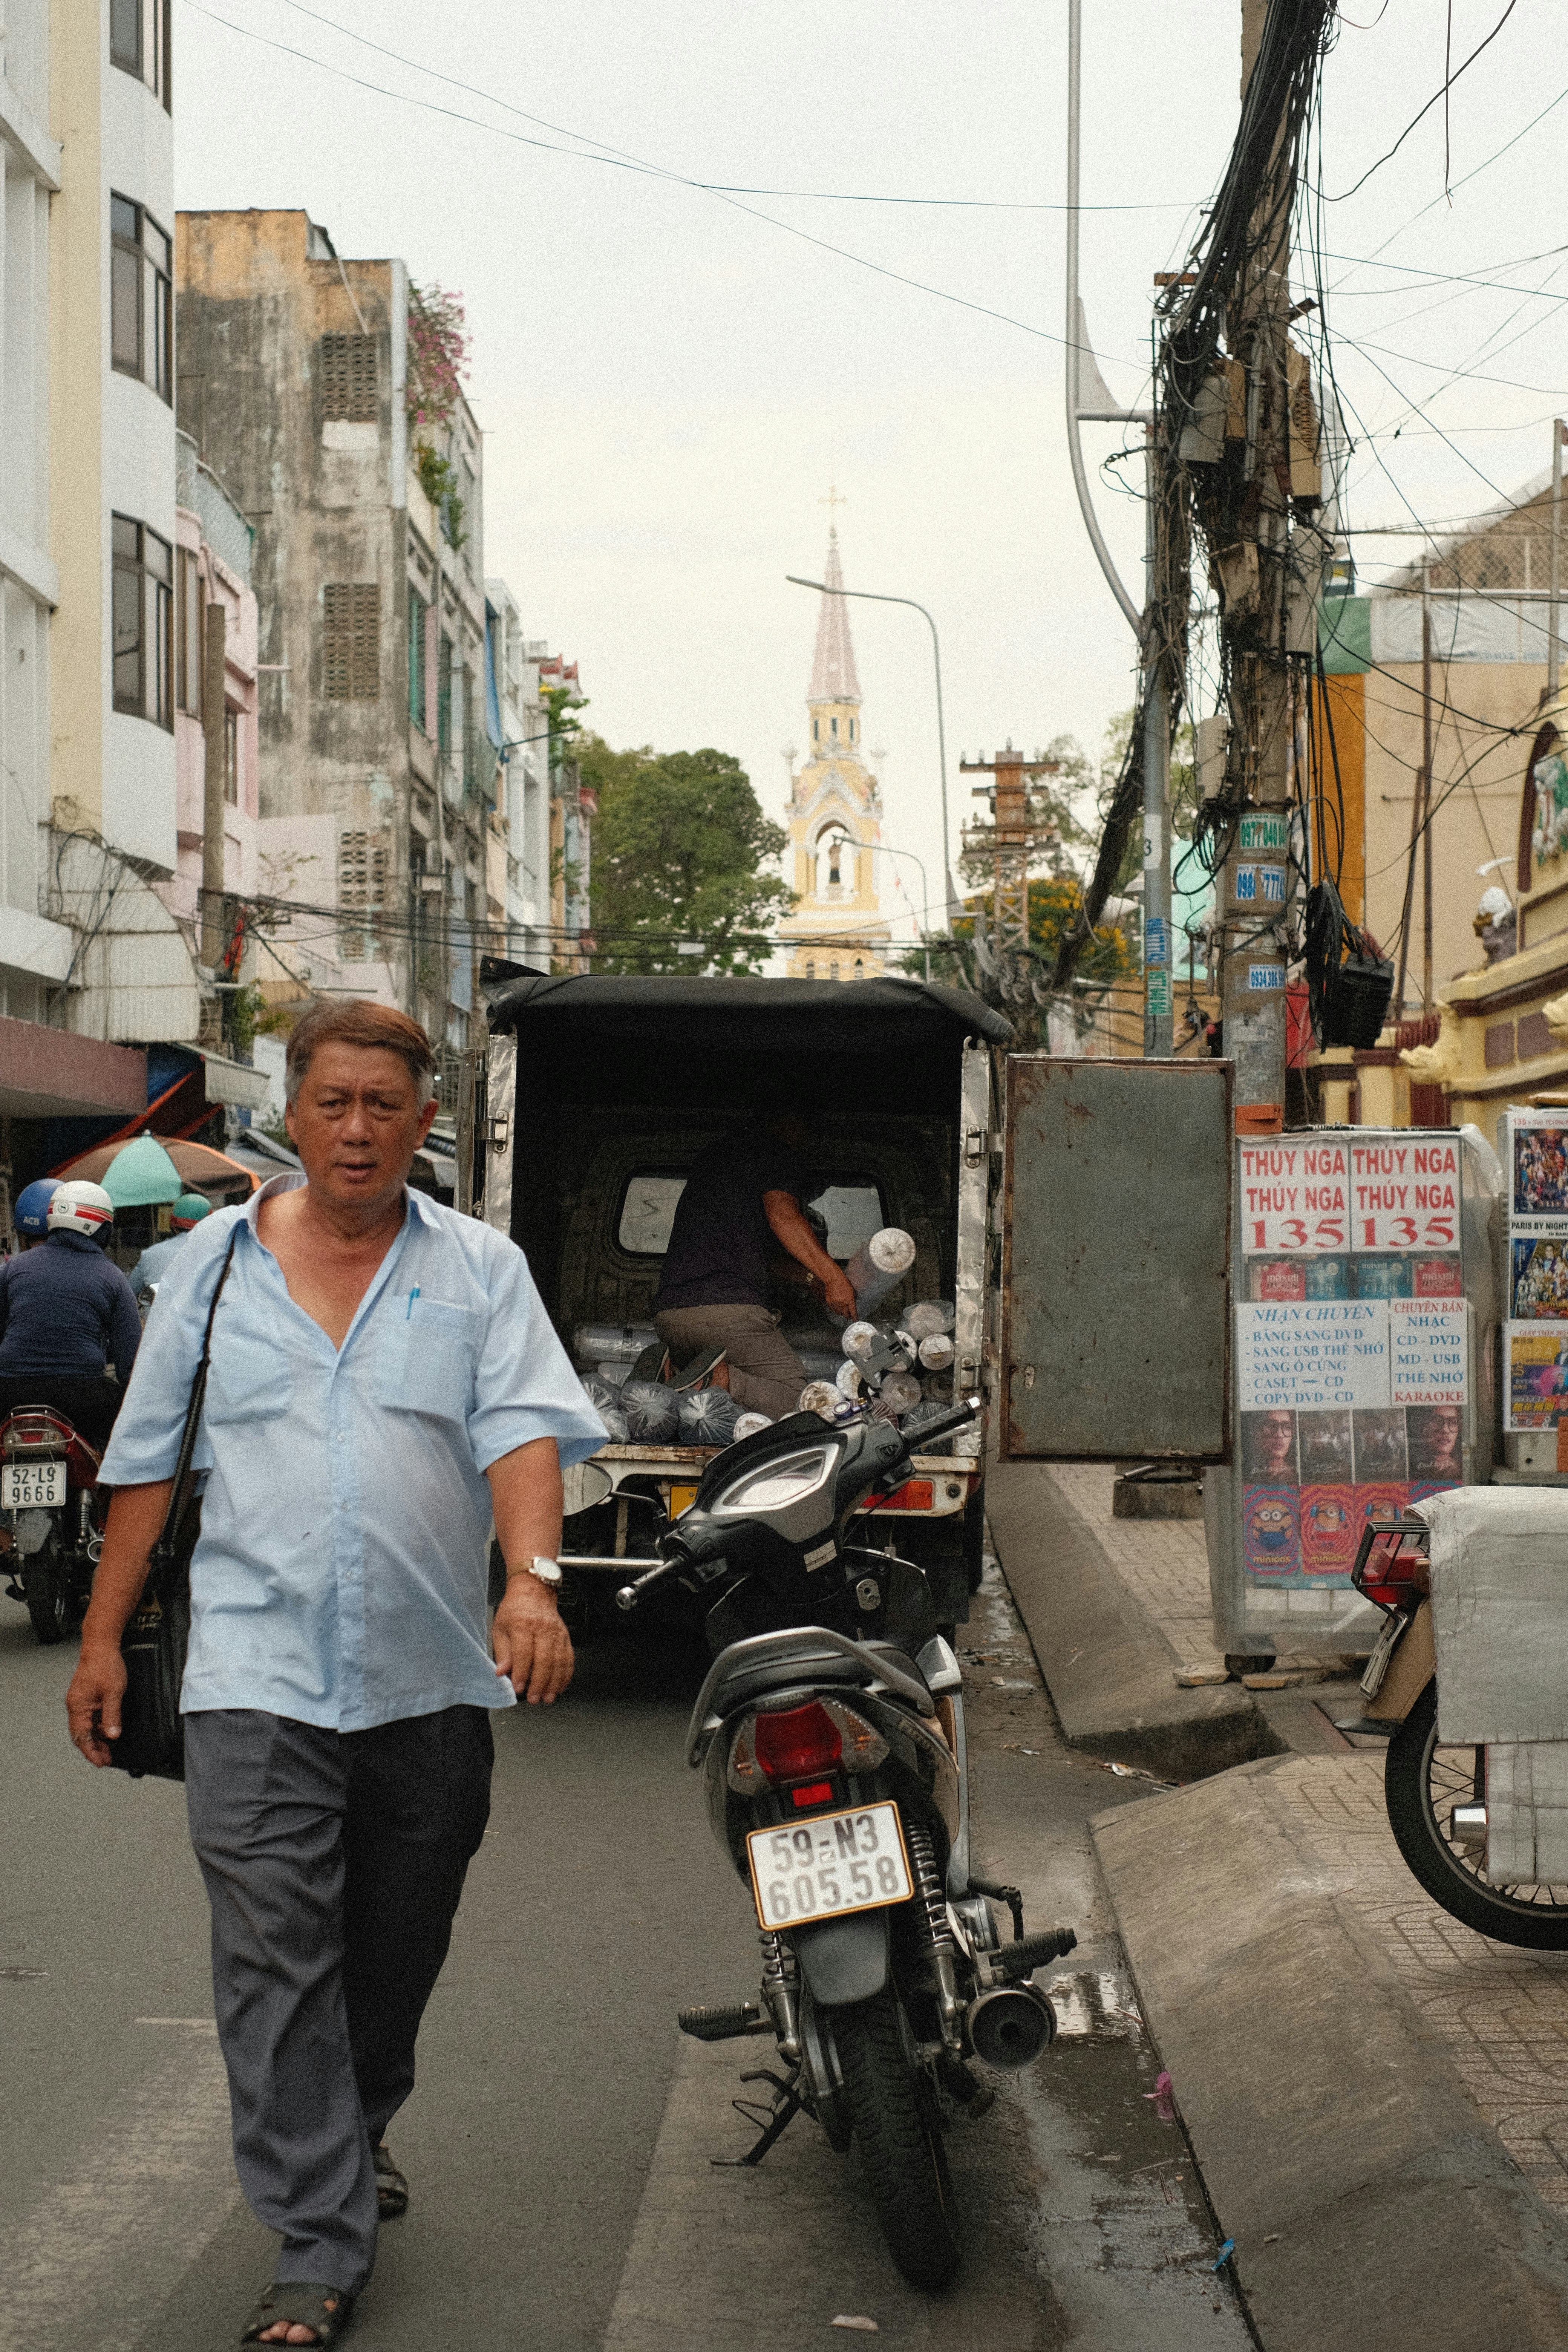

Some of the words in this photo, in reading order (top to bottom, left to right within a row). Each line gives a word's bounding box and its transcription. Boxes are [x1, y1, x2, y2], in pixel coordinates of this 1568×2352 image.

[1242, 1144, 1297, 1176] THÚY
[1304, 1149, 1345, 1175] NGA
[1353, 1143, 1407, 1174] THÚY
[1414, 1148, 1456, 1174] NGA
[1246, 1181, 1298, 1211] THÚY
[1305, 1187, 1345, 1211] NGA
[1357, 1179, 1408, 1210] THÚY
[1415, 1185, 1455, 1209] NGA
[23, 1216, 40, 1226] ACB
[1248, 1219, 1344, 1248] 135
[1358, 1217, 1454, 1246] 135
[1267, 1274, 1299, 1282] maxell
[1407, 1316, 1450, 1329] NHẠC
[1295, 1329, 1331, 1341] SANG
[1335, 1329, 1363, 1340] DVD
[1396, 1335, 1418, 1346] CD
[1430, 1335, 1461, 1346] DVD
[1253, 1346, 1289, 1357] SANG
[1294, 1345, 1319, 1357] USB
[1397, 1354, 1421, 1364] MD
[1433, 1354, 1461, 1364] USB
[1254, 1361, 1290, 1373] SANG
[1254, 1377, 1298, 1389] CASET
[1325, 1376, 1343, 1387] CD
[1429, 1370, 1464, 1383] NHỚ
[1255, 1392, 1292, 1404] COPY
[1295, 1392, 1323, 1403] DVD
[1335, 1391, 1354, 1402] CD
[1394, 1391, 1464, 1402] KARAOKE
[12, 1467, 56, 1484] 52-L9
[12, 1485, 55, 1504] 9666
[1253, 1554, 1291, 1563] minions
[1310, 1554, 1348, 1563] minions
[764, 1693, 805, 1707] HONDA
[770, 1815, 879, 1873] 59-N3
[768, 1856, 899, 1920] 605.58
